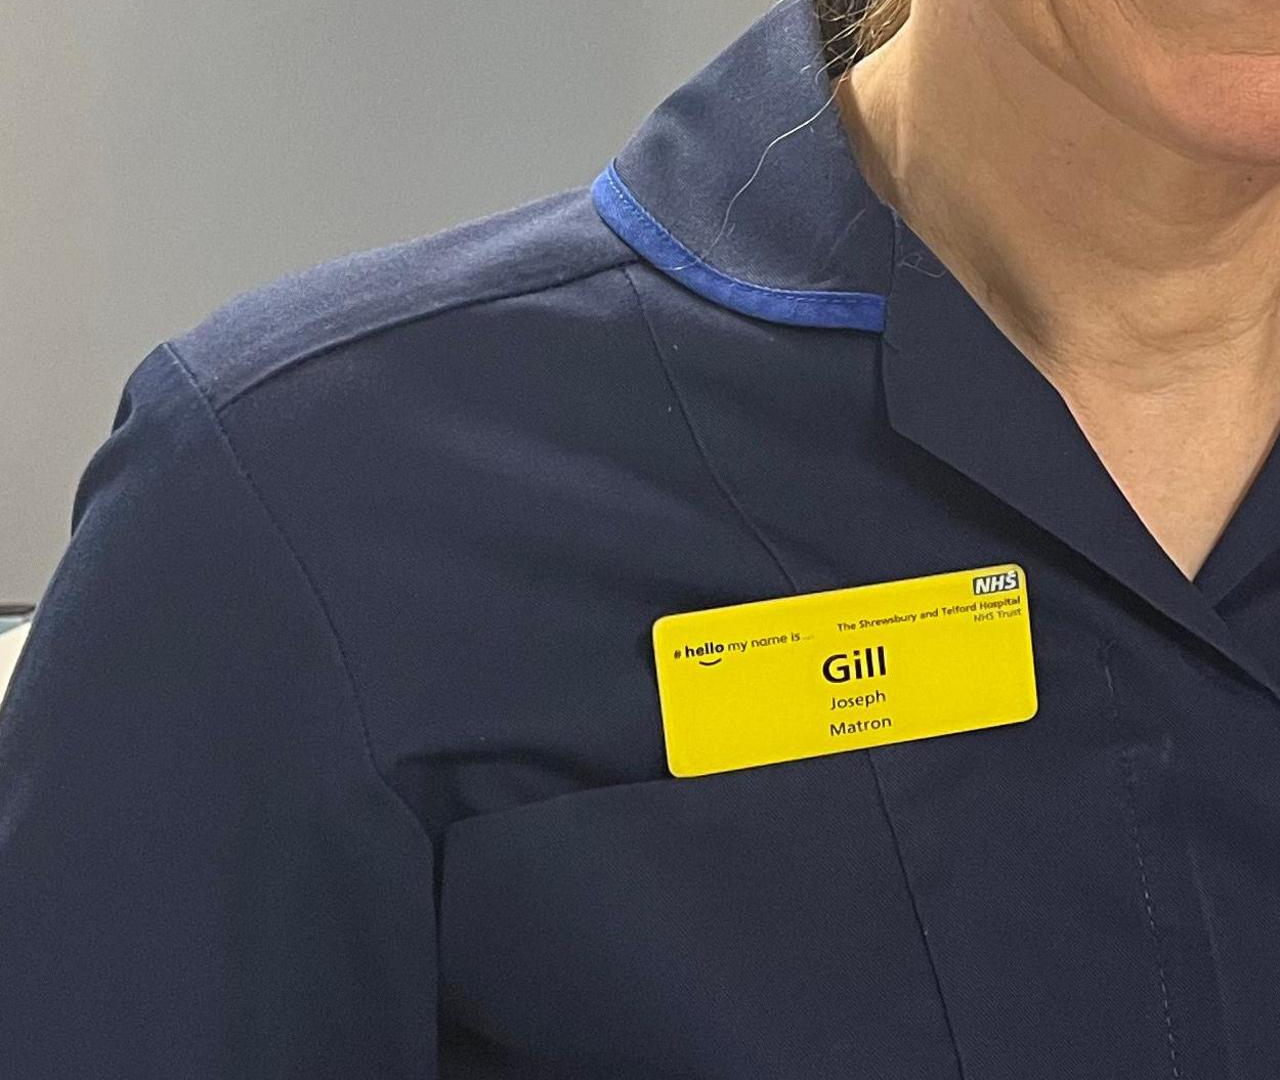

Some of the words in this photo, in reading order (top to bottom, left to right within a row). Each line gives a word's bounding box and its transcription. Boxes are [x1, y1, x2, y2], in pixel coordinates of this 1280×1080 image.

[975, 571, 1017, 594] NHS
[837, 622, 856, 633] The
[859, 612, 918, 629] Shrewsbury
[920, 608, 939, 620] and
[941, 603, 977, 617] Telford
[979, 595, 1021, 612] Hospital
[973, 612, 994, 623] NHS
[997, 607, 1022, 620] Trust
[685, 642, 724, 658] hello
[727, 640, 748, 653] my
[751, 633, 787, 648] name
[822, 646, 887, 684] Gill
[831, 690, 886, 710] Joseph
[830, 715, 892, 736] Matron
